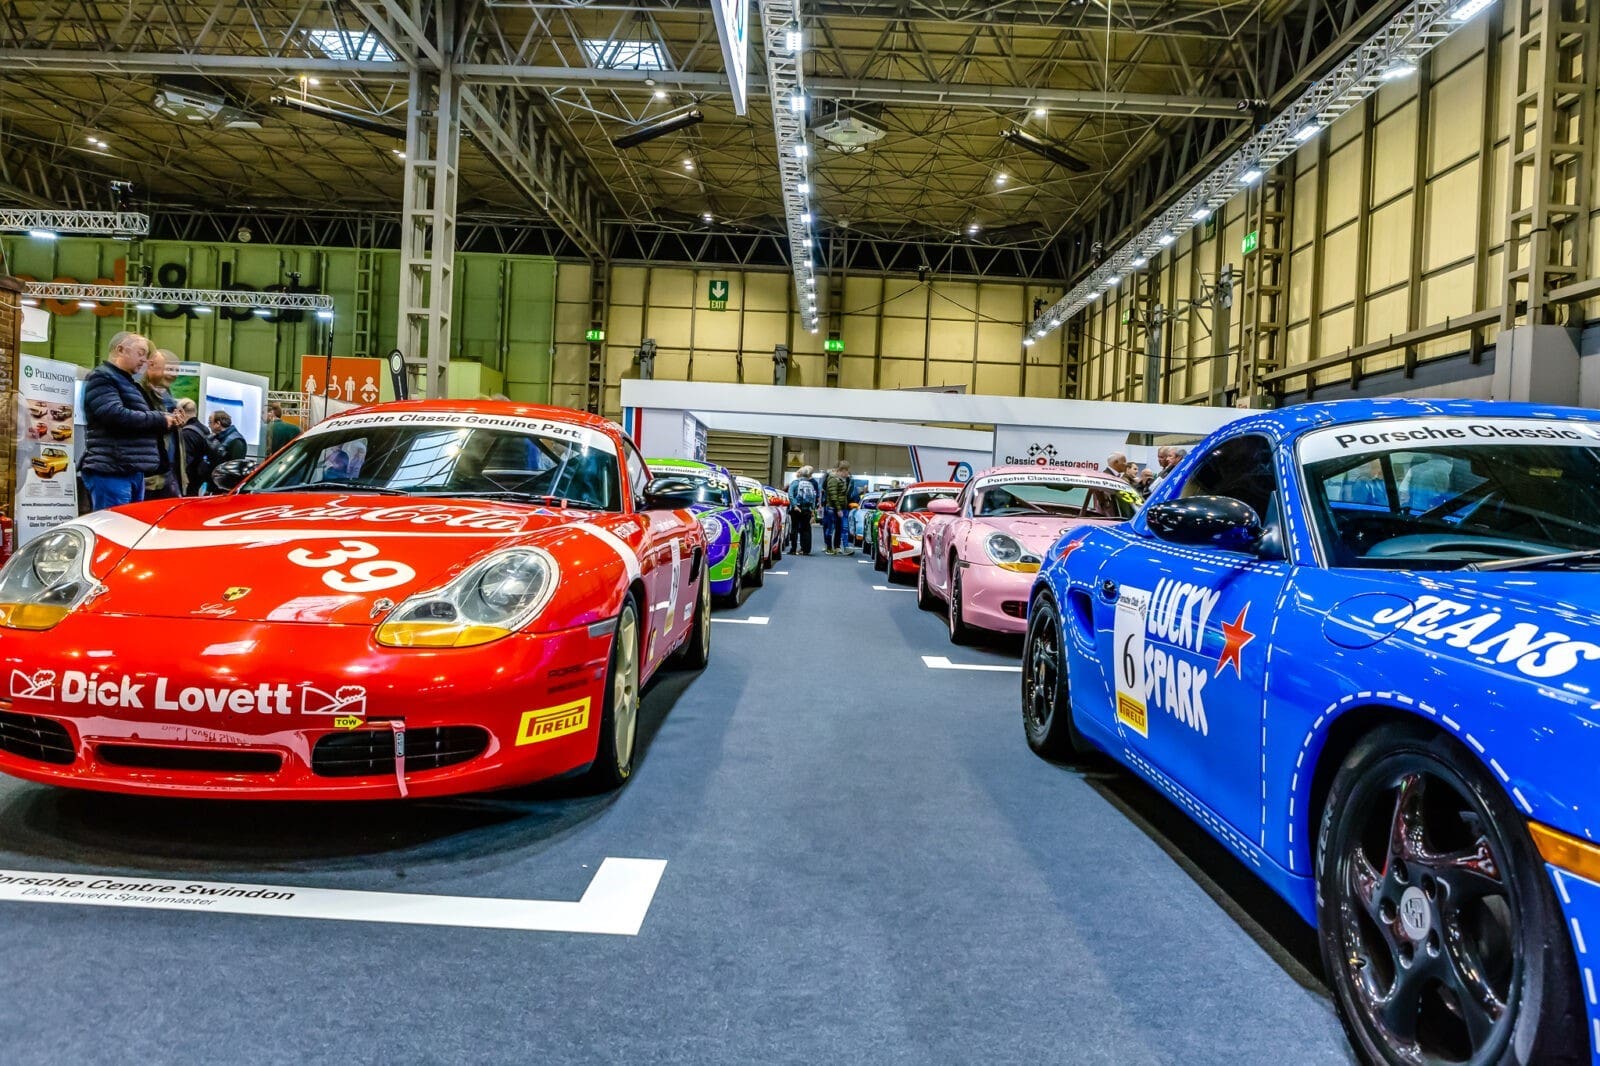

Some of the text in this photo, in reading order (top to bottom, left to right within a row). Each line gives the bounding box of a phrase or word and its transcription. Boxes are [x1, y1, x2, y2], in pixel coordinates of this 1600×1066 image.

[153, 263, 199, 320] &
[711, 301, 726, 309] EXIT
[35, 368, 75, 383] PILKINGTON
[326, 415, 395, 429] Porsche
[398, 413, 460, 423] Classic
[465, 415, 538, 430] Genuine
[1335, 425, 1463, 449] Porsche
[1468, 424, 1585, 441] Classic
[1005, 455, 1099, 471] Classic Restoracing
[707, 478, 728, 490] 35
[987, 475, 1026, 484] Porsche
[1063, 476, 1102, 486] Genuine
[287, 540, 416, 593] 39
[1147, 577, 1221, 653] LUCKY
[1372, 595, 1600, 678] JEANS
[1122, 632, 1136, 689] 6
[61, 670, 292, 715] Dick Lovett
[1144, 643, 1209, 737] SPARK
[335, 718, 358, 726] TOW
[526, 705, 586, 738] PIRELLI
[1118, 696, 1145, 728] PIRELLI
[21, 887, 217, 907] Dick Lovett Spraymaster
[87, 878, 177, 894] Centre
[179, 883, 296, 901] Swindon
